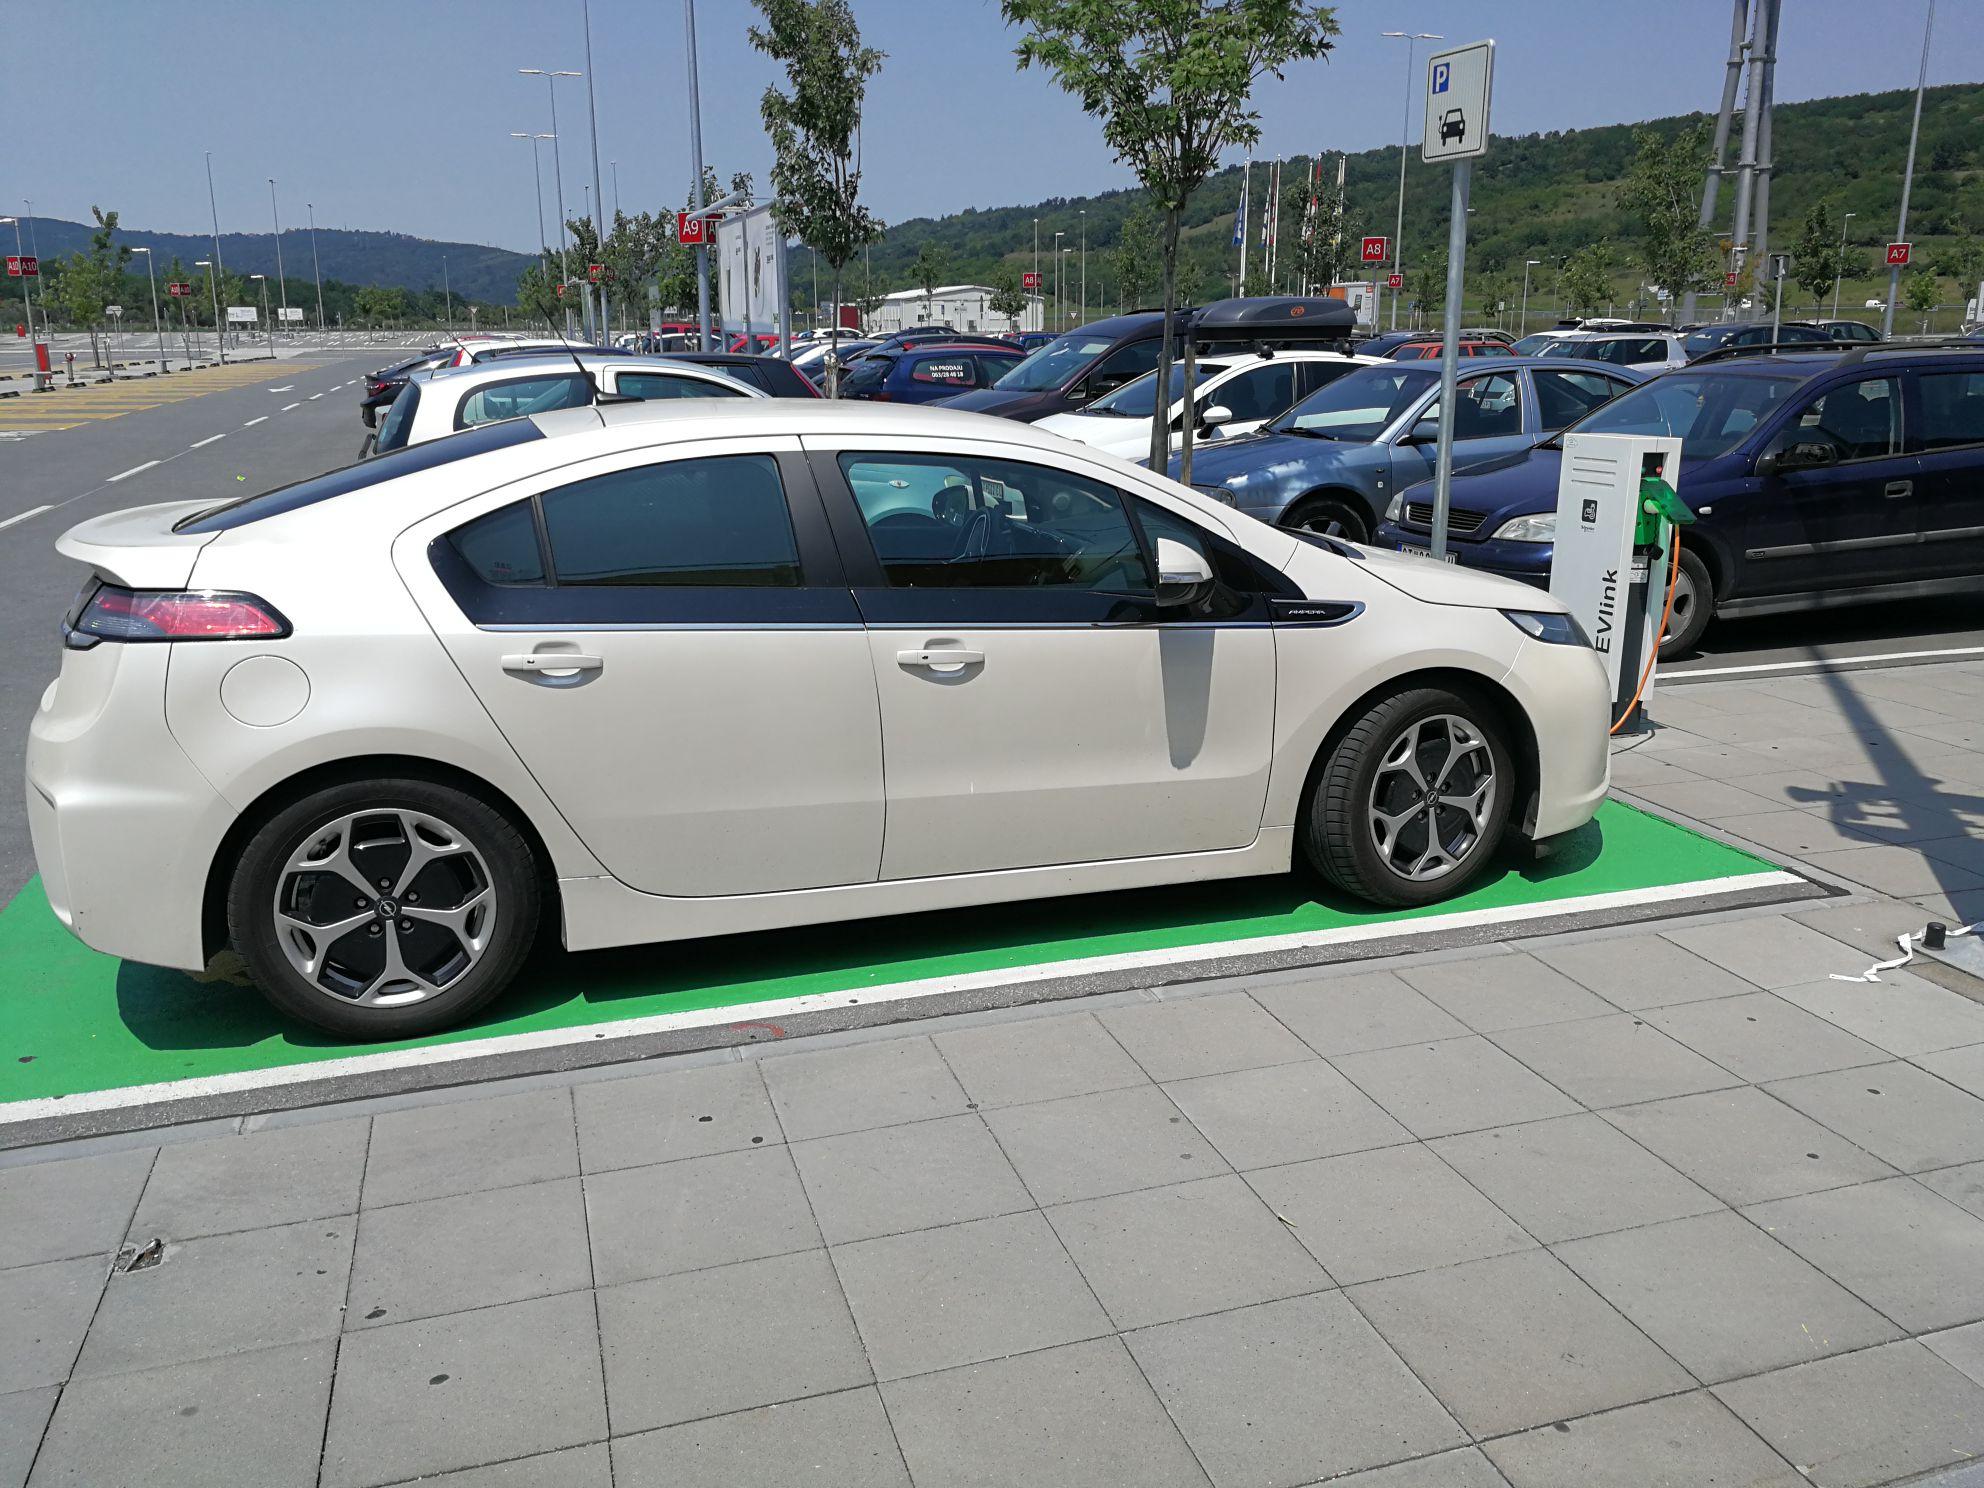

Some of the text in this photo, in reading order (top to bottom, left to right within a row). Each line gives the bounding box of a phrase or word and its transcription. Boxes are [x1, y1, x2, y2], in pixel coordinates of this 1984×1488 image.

[1435, 65, 1448, 93] P
[682, 220, 699, 235] A9
[1366, 243, 1382, 255] A8
[1890, 249, 1906, 259] A7
[9, 261, 19, 271] A10
[22, 262, 37, 271] A10
[1025, 276, 1034, 284] A8
[1390, 277, 1400, 285] A7
[1595, 569, 1618, 654] EVlink
